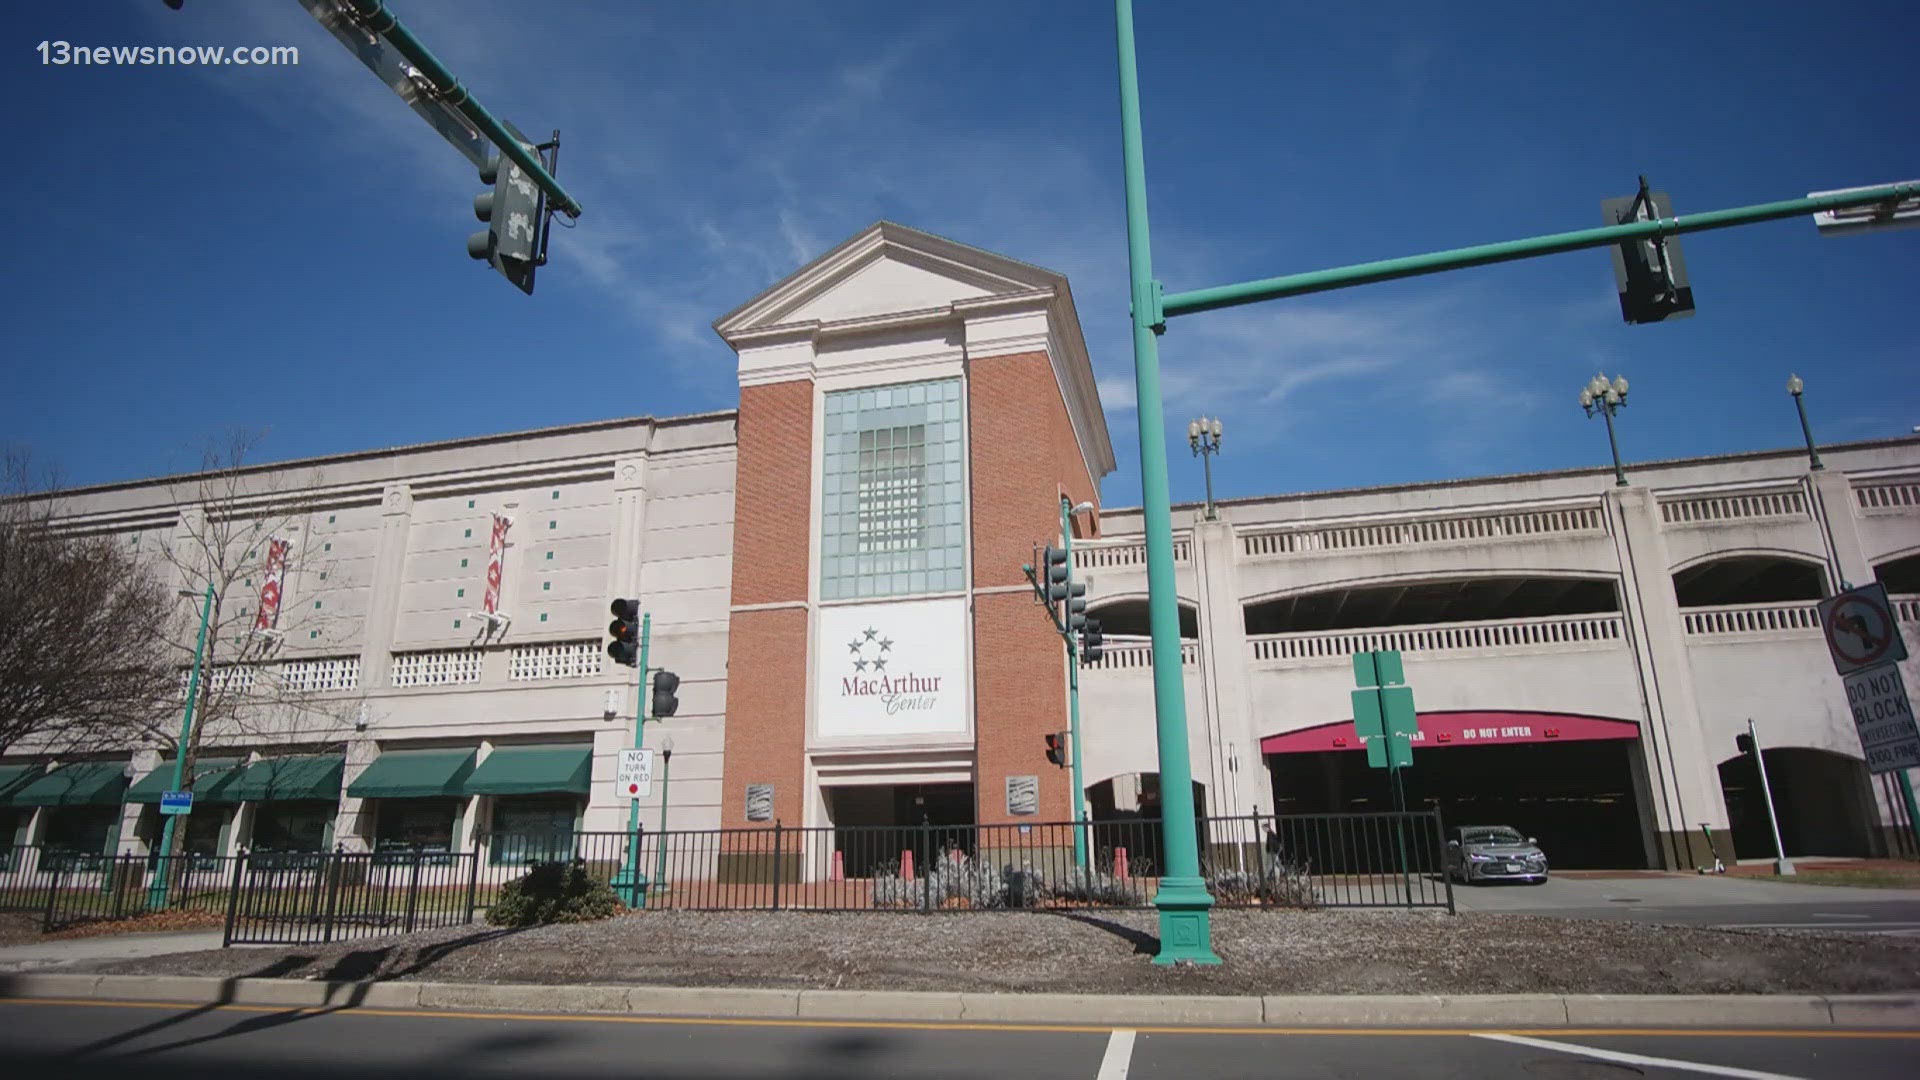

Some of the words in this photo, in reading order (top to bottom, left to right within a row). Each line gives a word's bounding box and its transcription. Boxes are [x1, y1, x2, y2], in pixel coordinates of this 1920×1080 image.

[841, 672, 942, 697] MacArthur
[1848, 682, 1867, 704] DO
[1868, 672, 1898, 697] NOT
[880, 692, 937, 716] Center
[1855, 697, 1907, 725] BLOCK
[1463, 728, 1477, 739] DO
[1479, 727, 1498, 739] NOT
[1501, 726, 1532, 738] ENTER
[628, 752, 644, 762] NO
[625, 763, 646, 772] TURN
[619, 774, 631, 782] ON
[633, 774, 650, 782] RED
